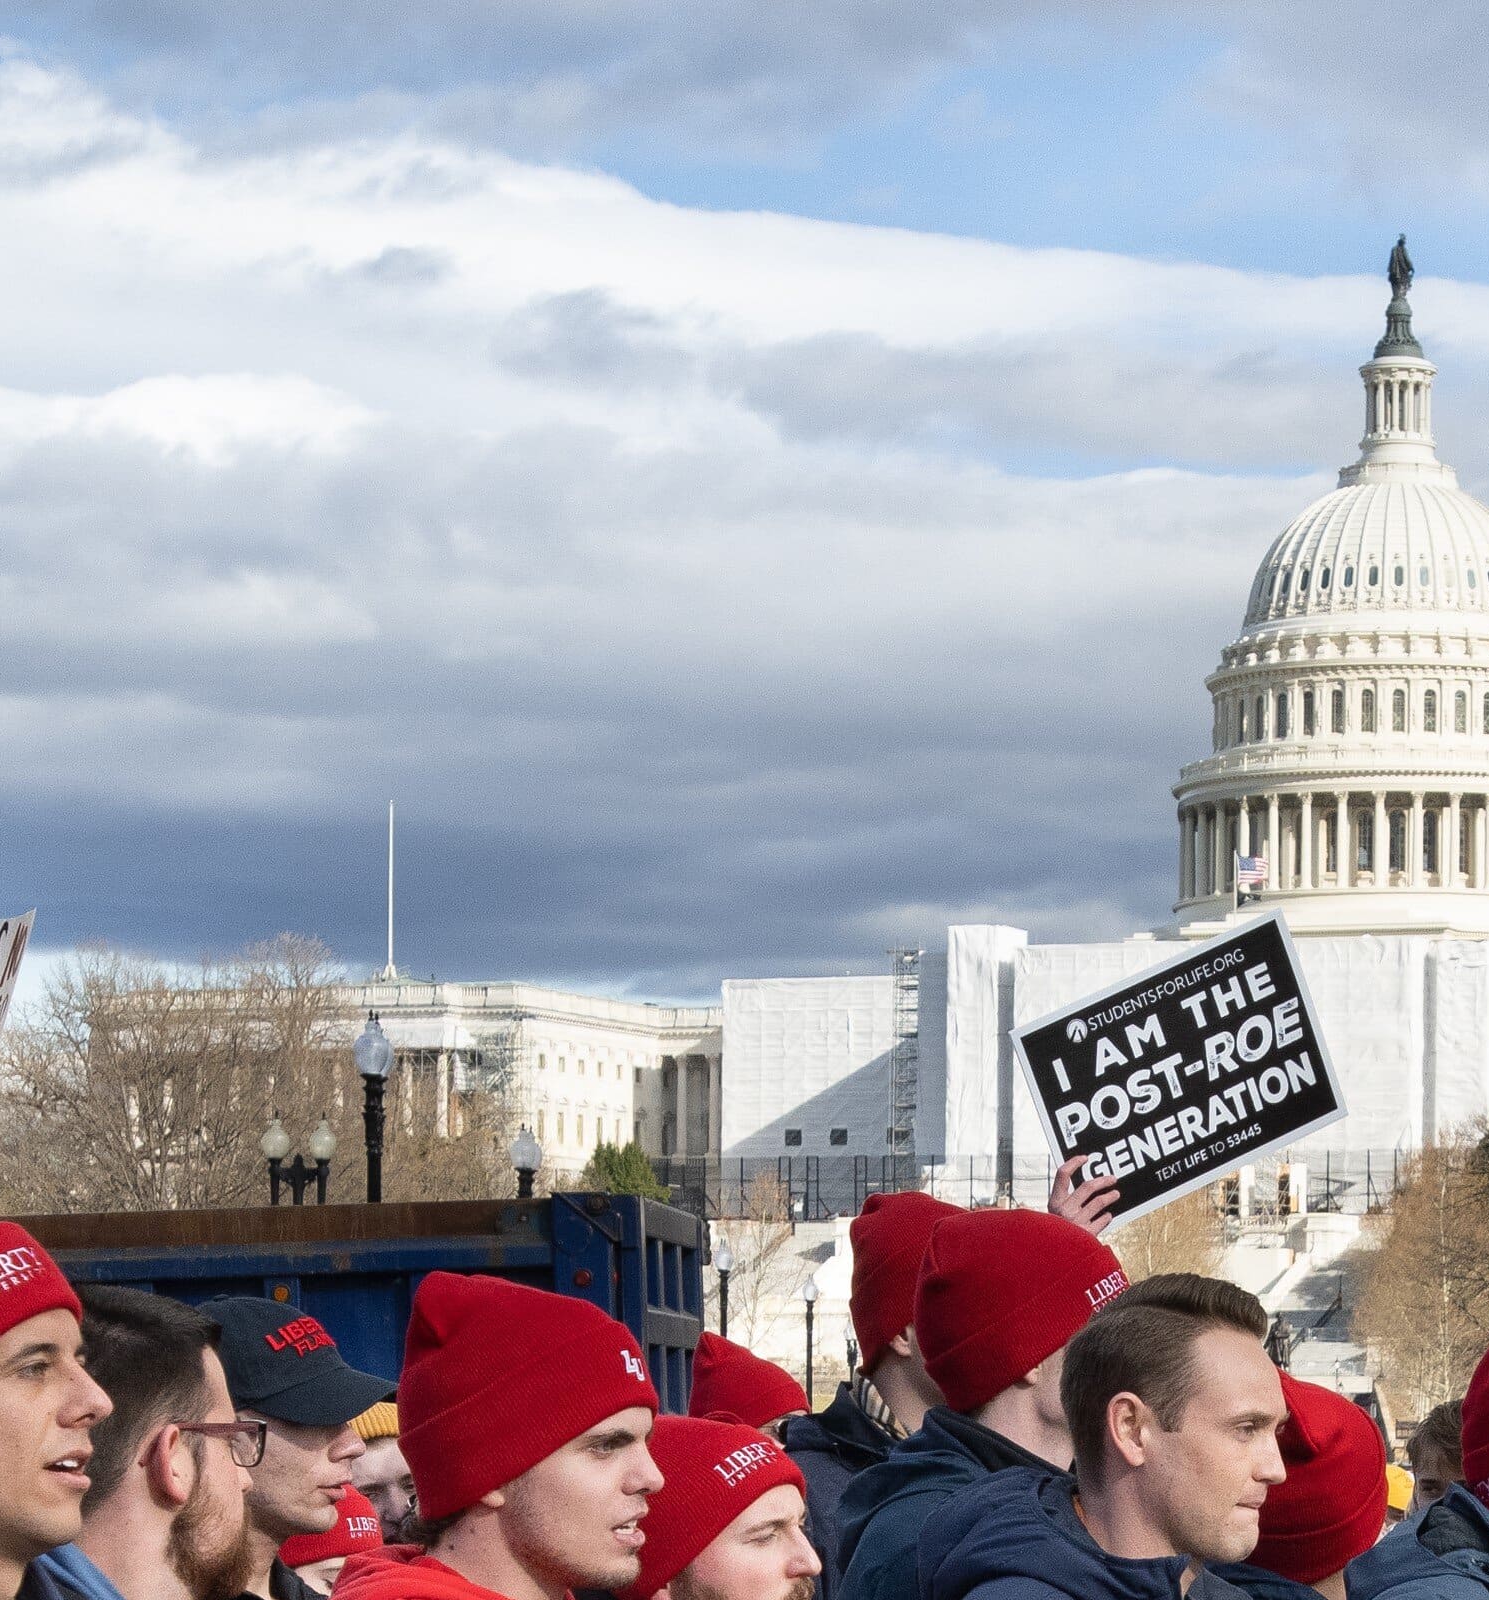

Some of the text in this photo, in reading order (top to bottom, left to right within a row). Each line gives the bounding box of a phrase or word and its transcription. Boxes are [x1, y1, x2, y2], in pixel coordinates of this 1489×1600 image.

[1052, 962, 1276, 1092] I AM THE
[1088, 949, 1245, 1031] STUDENTSFORLIFE.ORG
[1055, 997, 1304, 1149] POST-ROE
[1081, 1052, 1317, 1186] GENERATION
[1155, 1123, 1261, 1182] TEXT LIFE TO 53445
